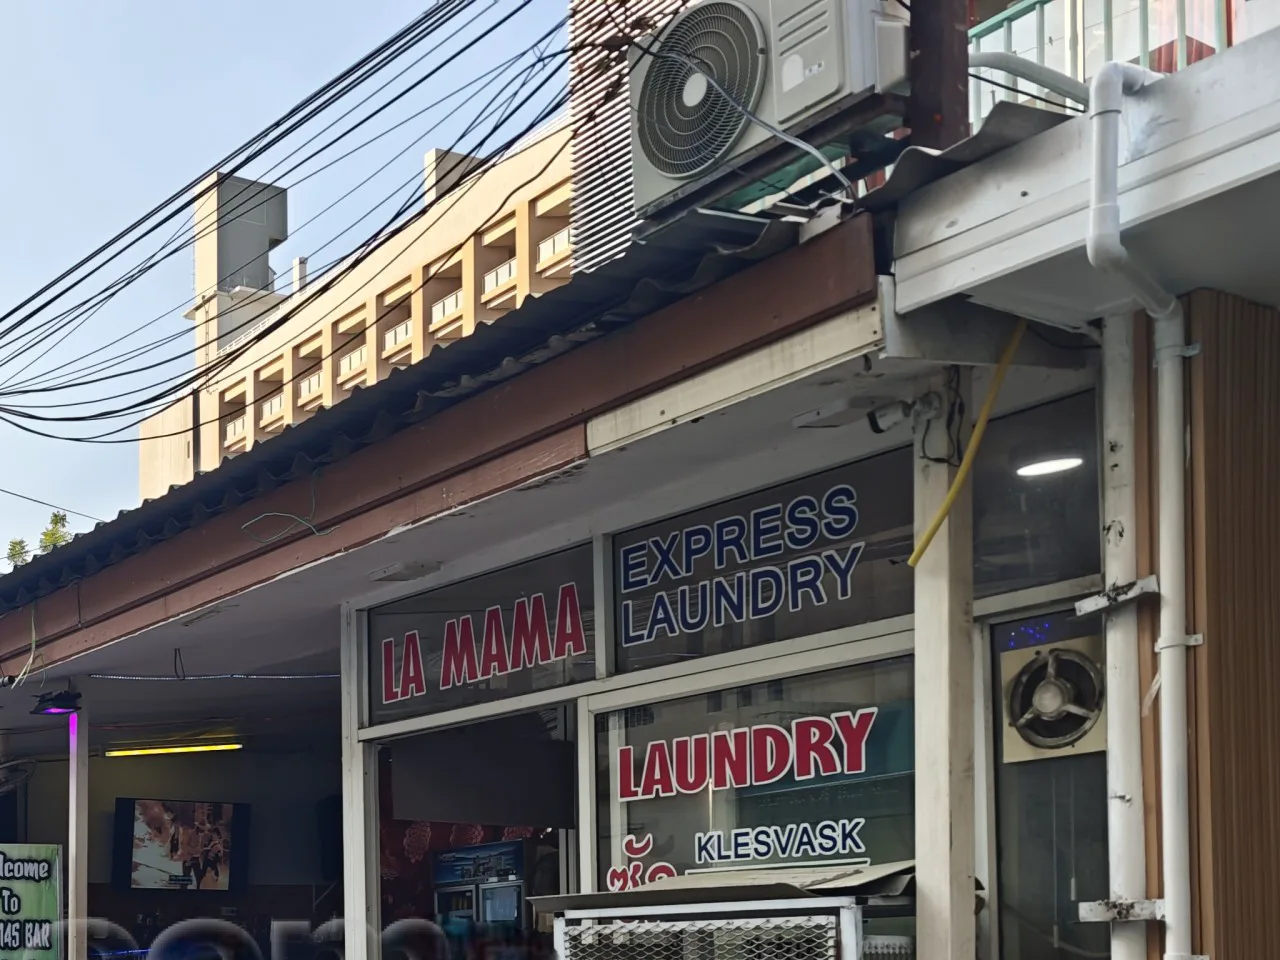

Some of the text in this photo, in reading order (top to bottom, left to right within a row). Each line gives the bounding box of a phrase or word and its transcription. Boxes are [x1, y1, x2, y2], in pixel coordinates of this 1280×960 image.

[620, 484, 860, 593] EXPRESS
[621, 541, 866, 648] LAUNDRY
[381, 581, 588, 704] LA MAMA
[618, 706, 879, 801] LAUNDRY
[694, 818, 866, 864] KLESVASK
[1, 889, 19, 912] To
[24, 921, 52, 948] BAR
